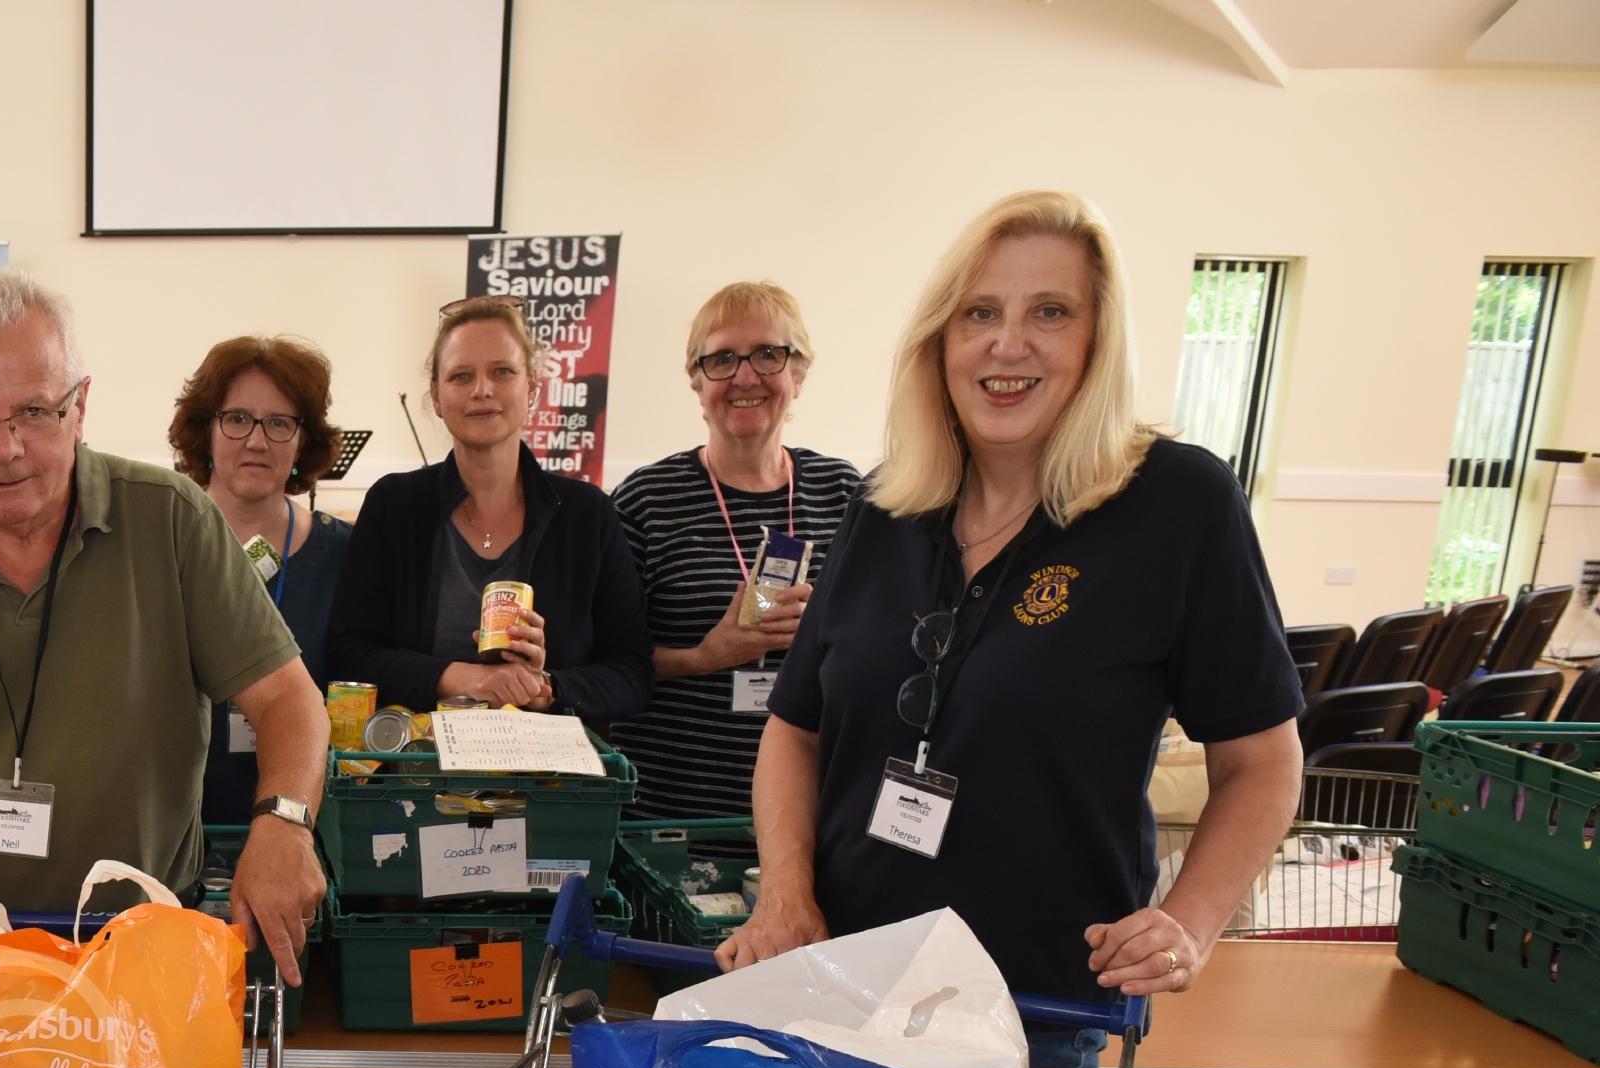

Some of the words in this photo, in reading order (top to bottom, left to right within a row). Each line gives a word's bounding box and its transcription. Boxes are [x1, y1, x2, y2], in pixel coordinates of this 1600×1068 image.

[478, 236, 606, 271] JESUS
[487, 268, 610, 297] Saviour
[527, 299, 586, 321] Lord
[527, 317, 592, 351] ighty
[547, 378, 588, 407] One
[538, 410, 587, 429] Kings
[521, 430, 595, 450] EEMER
[486, 591, 515, 606] HEINZ
[2, 839, 20, 849] Neil
[889, 825, 921, 846] Theresa
